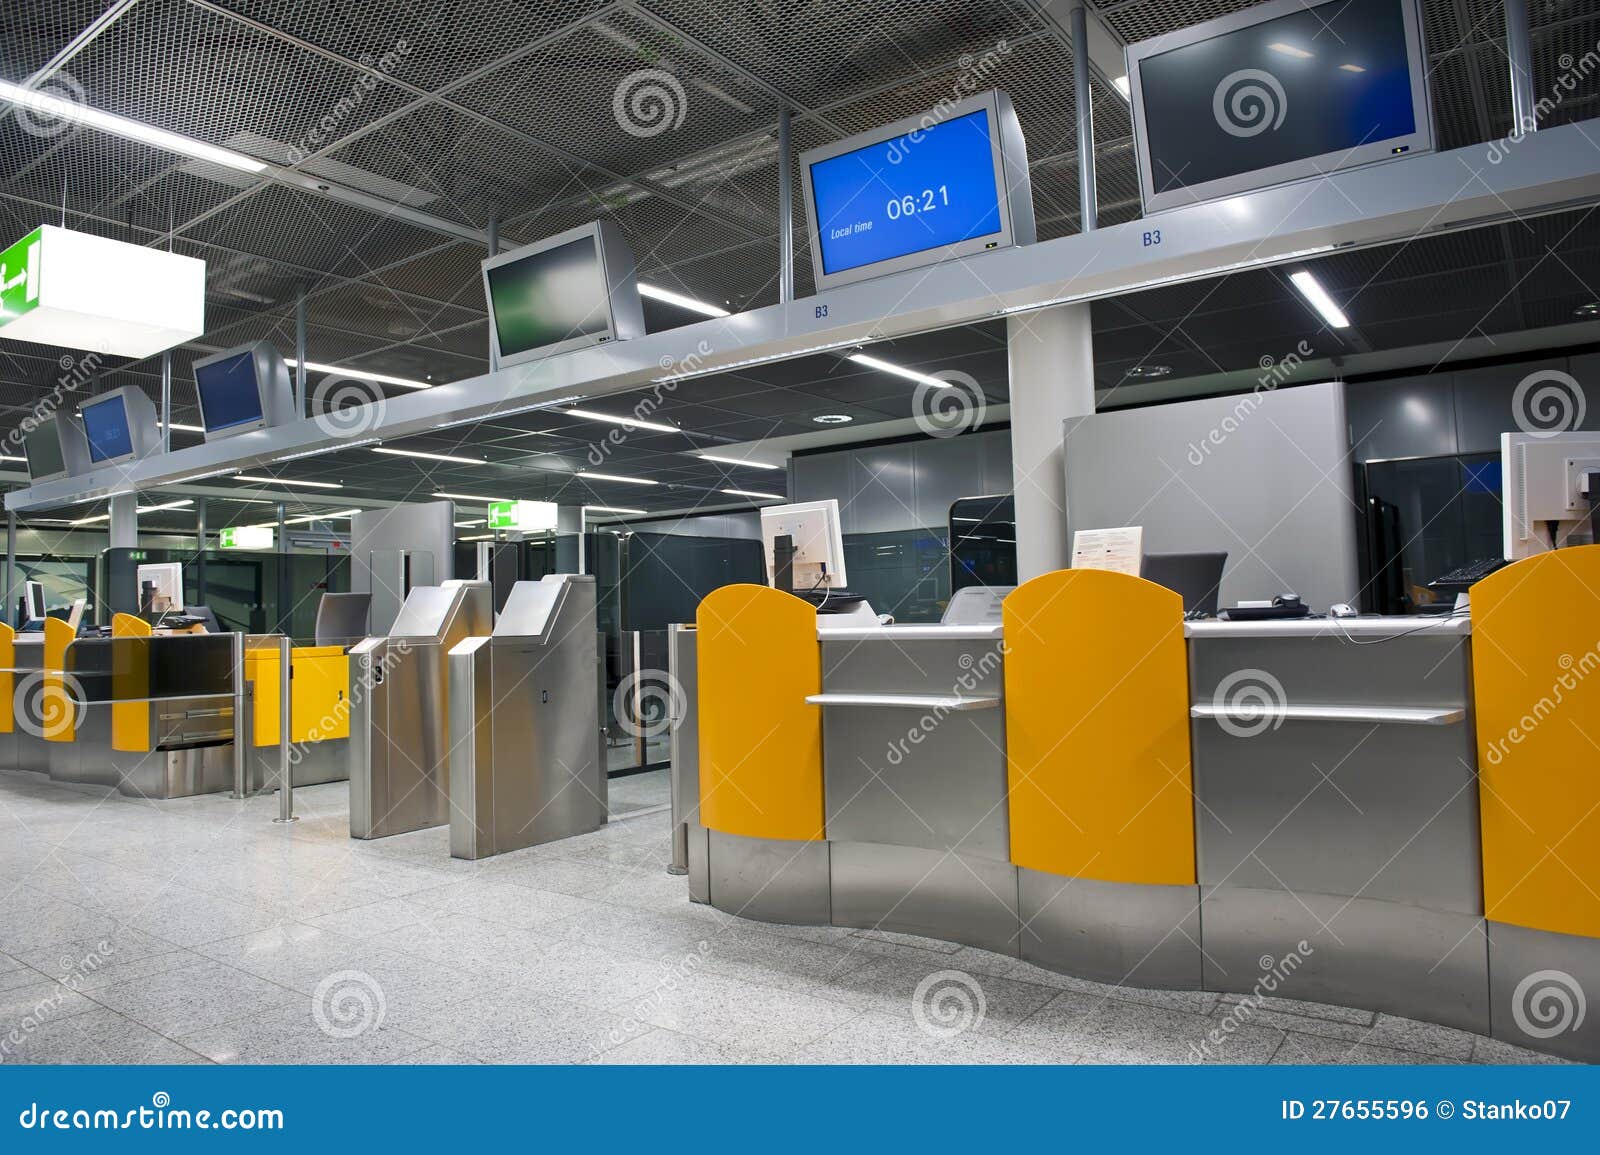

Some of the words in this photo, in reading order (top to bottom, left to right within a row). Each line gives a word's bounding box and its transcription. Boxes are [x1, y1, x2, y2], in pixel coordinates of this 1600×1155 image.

[887, 184, 950, 220] 06:21
[831, 224, 852, 240] Local
[855, 220, 873, 233] time
[1143, 230, 1161, 247] B3
[815, 304, 828, 319] B3
